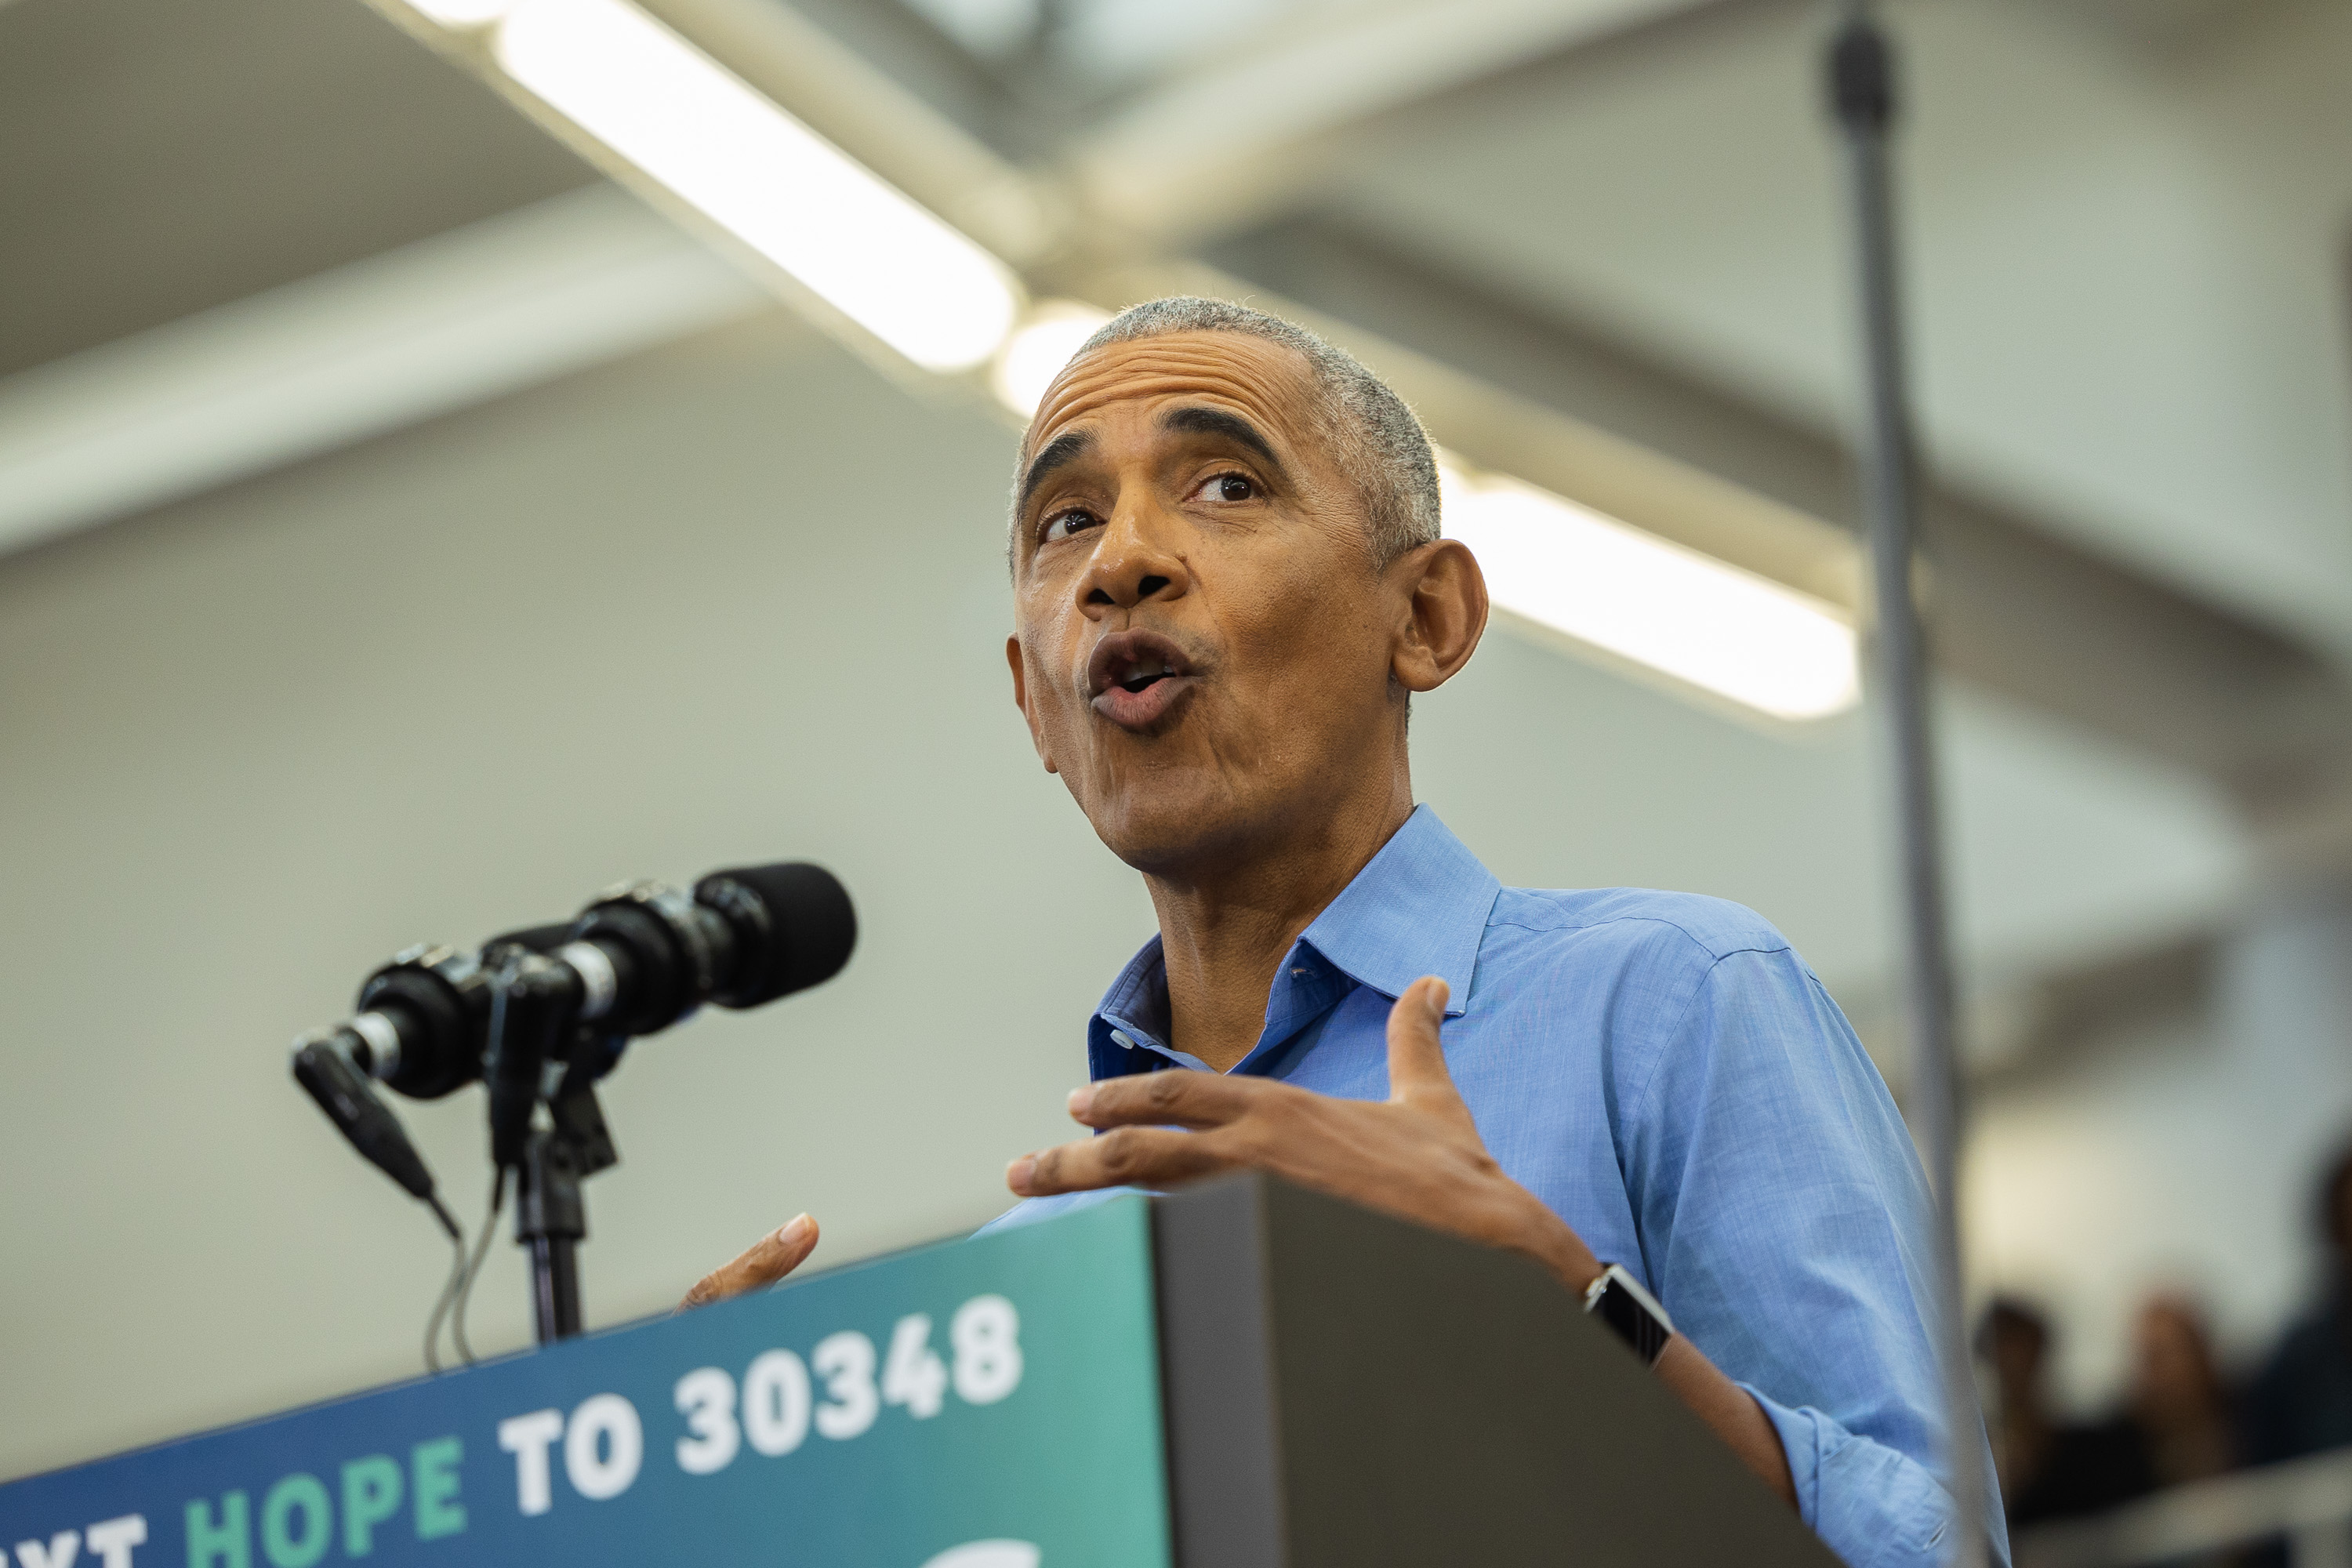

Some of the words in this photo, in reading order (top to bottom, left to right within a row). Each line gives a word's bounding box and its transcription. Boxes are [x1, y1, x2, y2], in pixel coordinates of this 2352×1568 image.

[184, 1436, 467, 1568] HOPE
[498, 1393, 643, 1515] TO
[673, 1294, 1023, 1475] 30348
